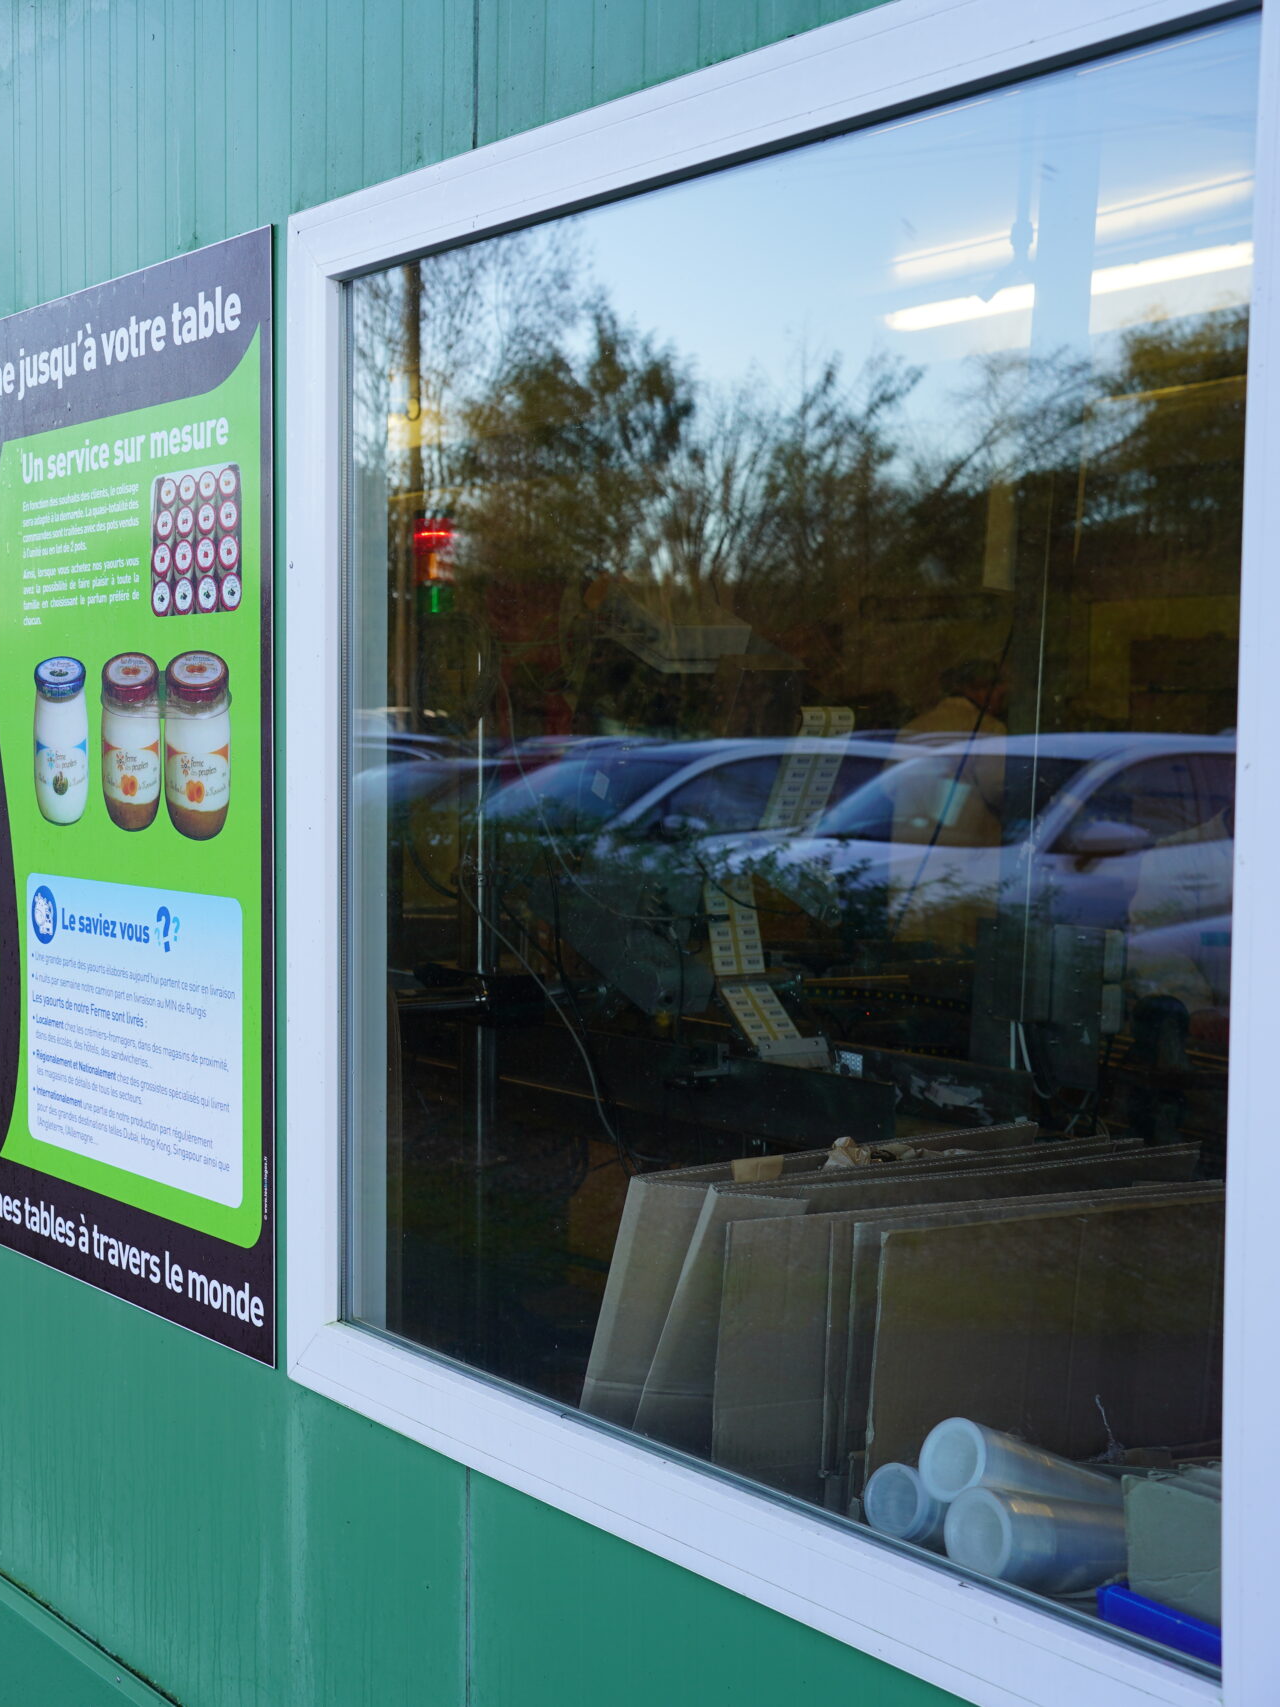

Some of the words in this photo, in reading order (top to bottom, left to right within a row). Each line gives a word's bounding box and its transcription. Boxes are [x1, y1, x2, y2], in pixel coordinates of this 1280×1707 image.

[18, 323, 96, 400] jusqu'à
[101, 315, 165, 366] votre
[171, 286, 241, 346] table
[22, 449, 43, 484] Un
[48, 443, 110, 478] service
[115, 435, 143, 464] sur
[150, 416, 228, 459] mesure
[62, 908, 75, 931] Le
[79, 913, 117, 939] saviez
[120, 921, 150, 944] vous
[33, 991, 42, 1004] Les
[44, 996, 64, 1009] yaourts
[66, 998, 72, 1011] de
[74, 1003, 89, 1014] notre
[91, 1004, 110, 1019] Ferme
[112, 1011, 125, 1023] sont
[36, 1015, 64, 1030] Localement
[187, 1004, 207, 1019] Rungis
[24, 1196, 75, 1247] tables
[79, 1214, 89, 1254] à
[93, 1225, 160, 1284] travers
[165, 1251, 183, 1293] le
[188, 1267, 265, 1327] monde
